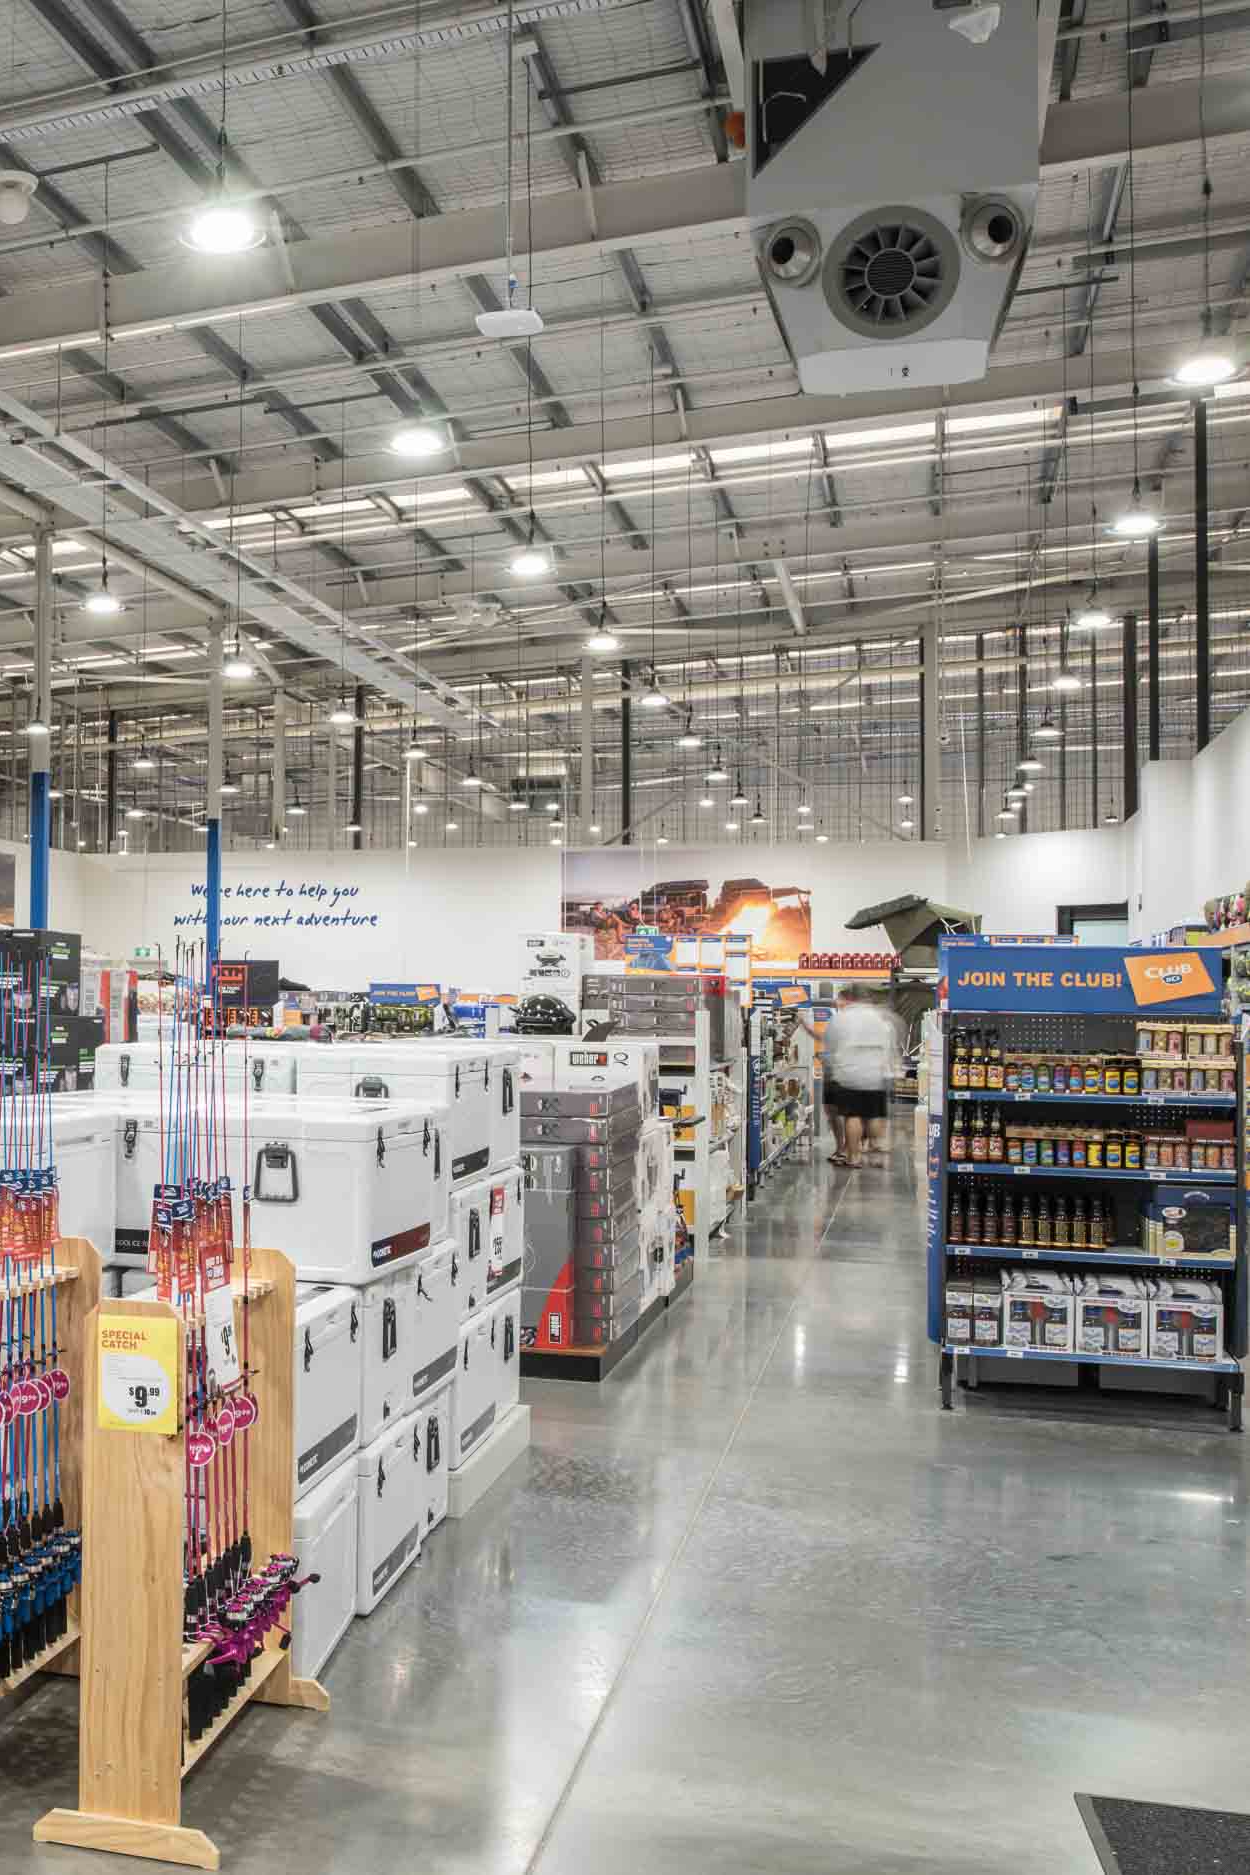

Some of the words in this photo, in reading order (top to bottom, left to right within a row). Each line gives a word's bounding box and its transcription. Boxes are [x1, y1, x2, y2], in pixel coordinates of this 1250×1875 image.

[236, 880, 270, 898] here
[275, 880, 294, 897] to
[298, 883, 328, 901] help
[333, 886, 359, 908] you
[219, 915, 249, 926] our
[253, 908, 293, 926] next
[296, 908, 378, 926] adventure
[957, 971, 1006, 988] JOIN
[1012, 971, 1054, 988] THE
[1060, 971, 1123, 988] CLUB!
[1144, 963, 1193, 980] CLUB
[101, 1329, 149, 1341] SPECIAL
[101, 1340, 138, 1350] CATCH
